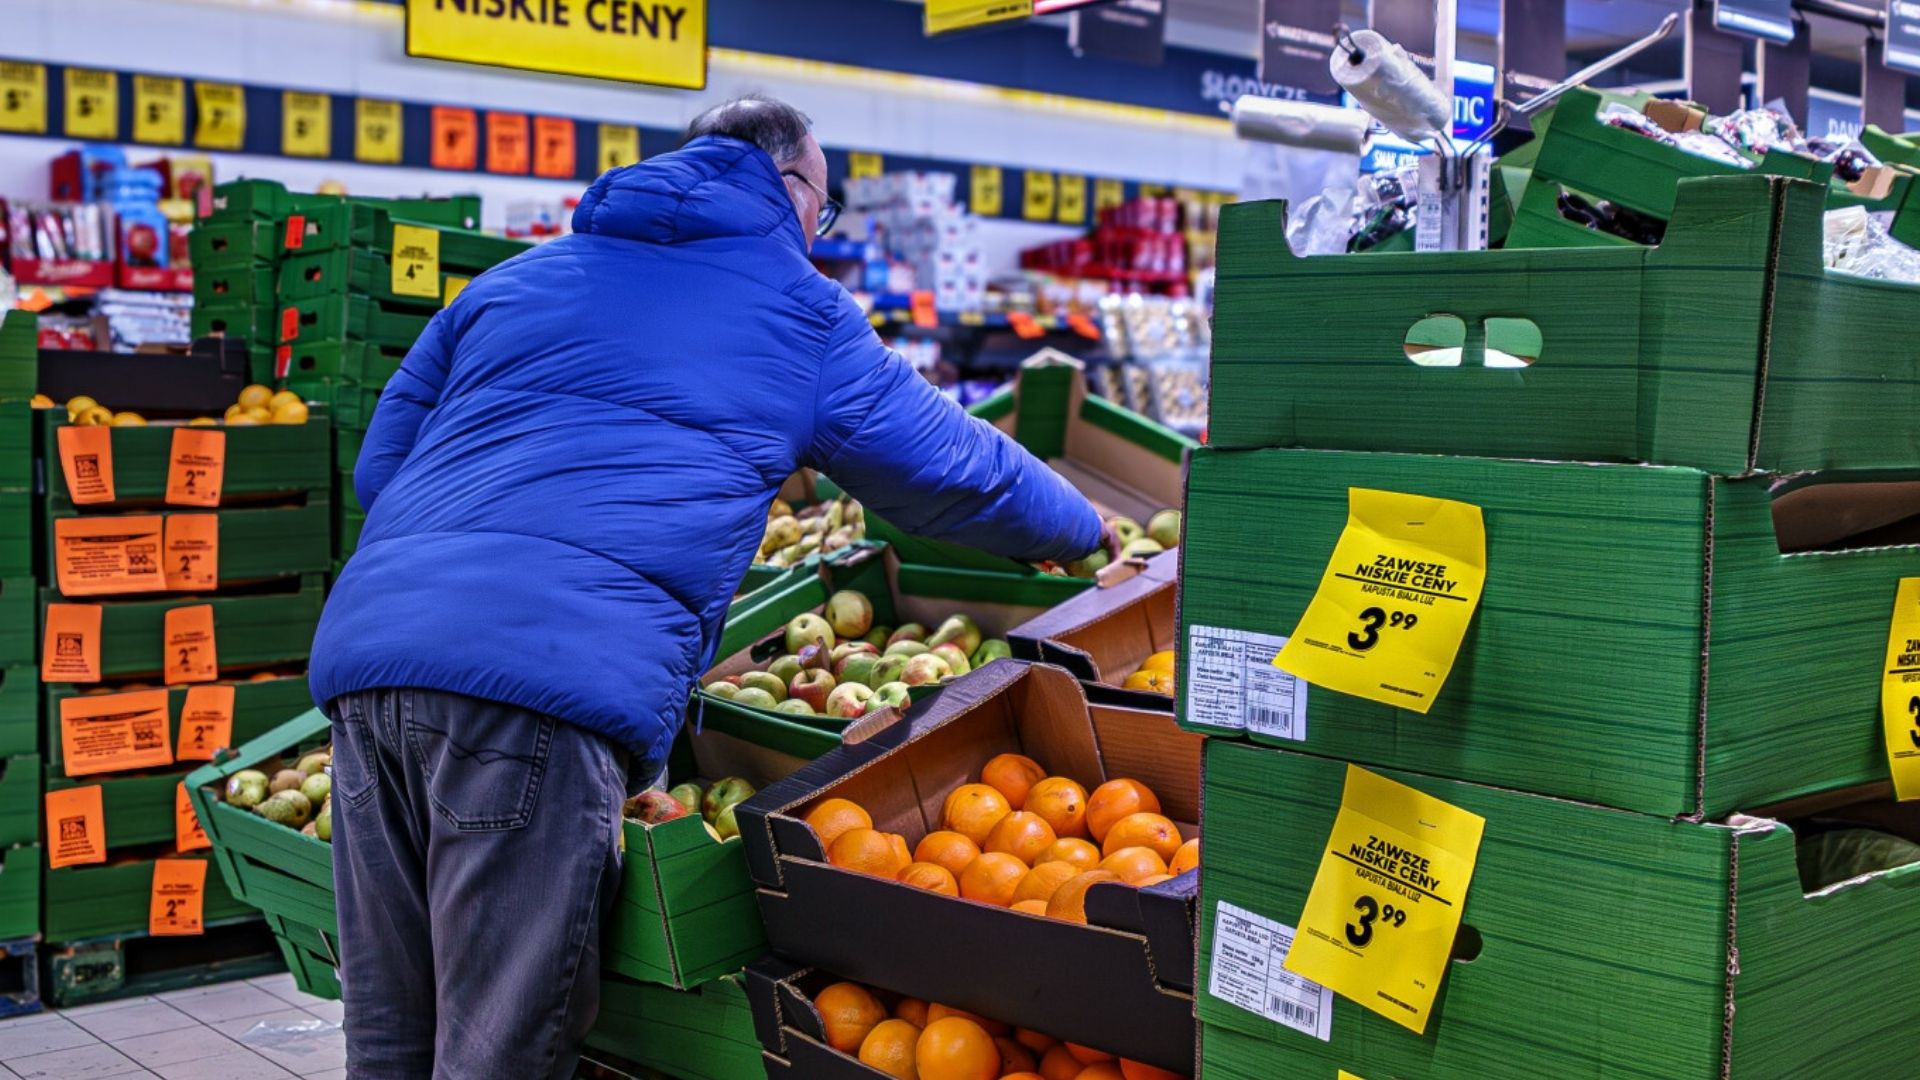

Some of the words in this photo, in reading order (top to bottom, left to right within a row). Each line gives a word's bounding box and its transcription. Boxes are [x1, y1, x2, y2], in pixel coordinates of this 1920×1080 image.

[585, 0, 686, 41] CENY
[1355, 563, 1410, 584] NISKIE
[1411, 575, 1458, 592] CENY
[1374, 554, 1447, 578] ZAWSZE
[1361, 583, 1396, 599] KAPUSTA
[1349, 843, 1399, 874] NISKIE
[1399, 866, 1440, 891] CENY
[1366, 835, 1431, 873] ZAWSZE
[1354, 868, 1387, 887] KAPUSTA
